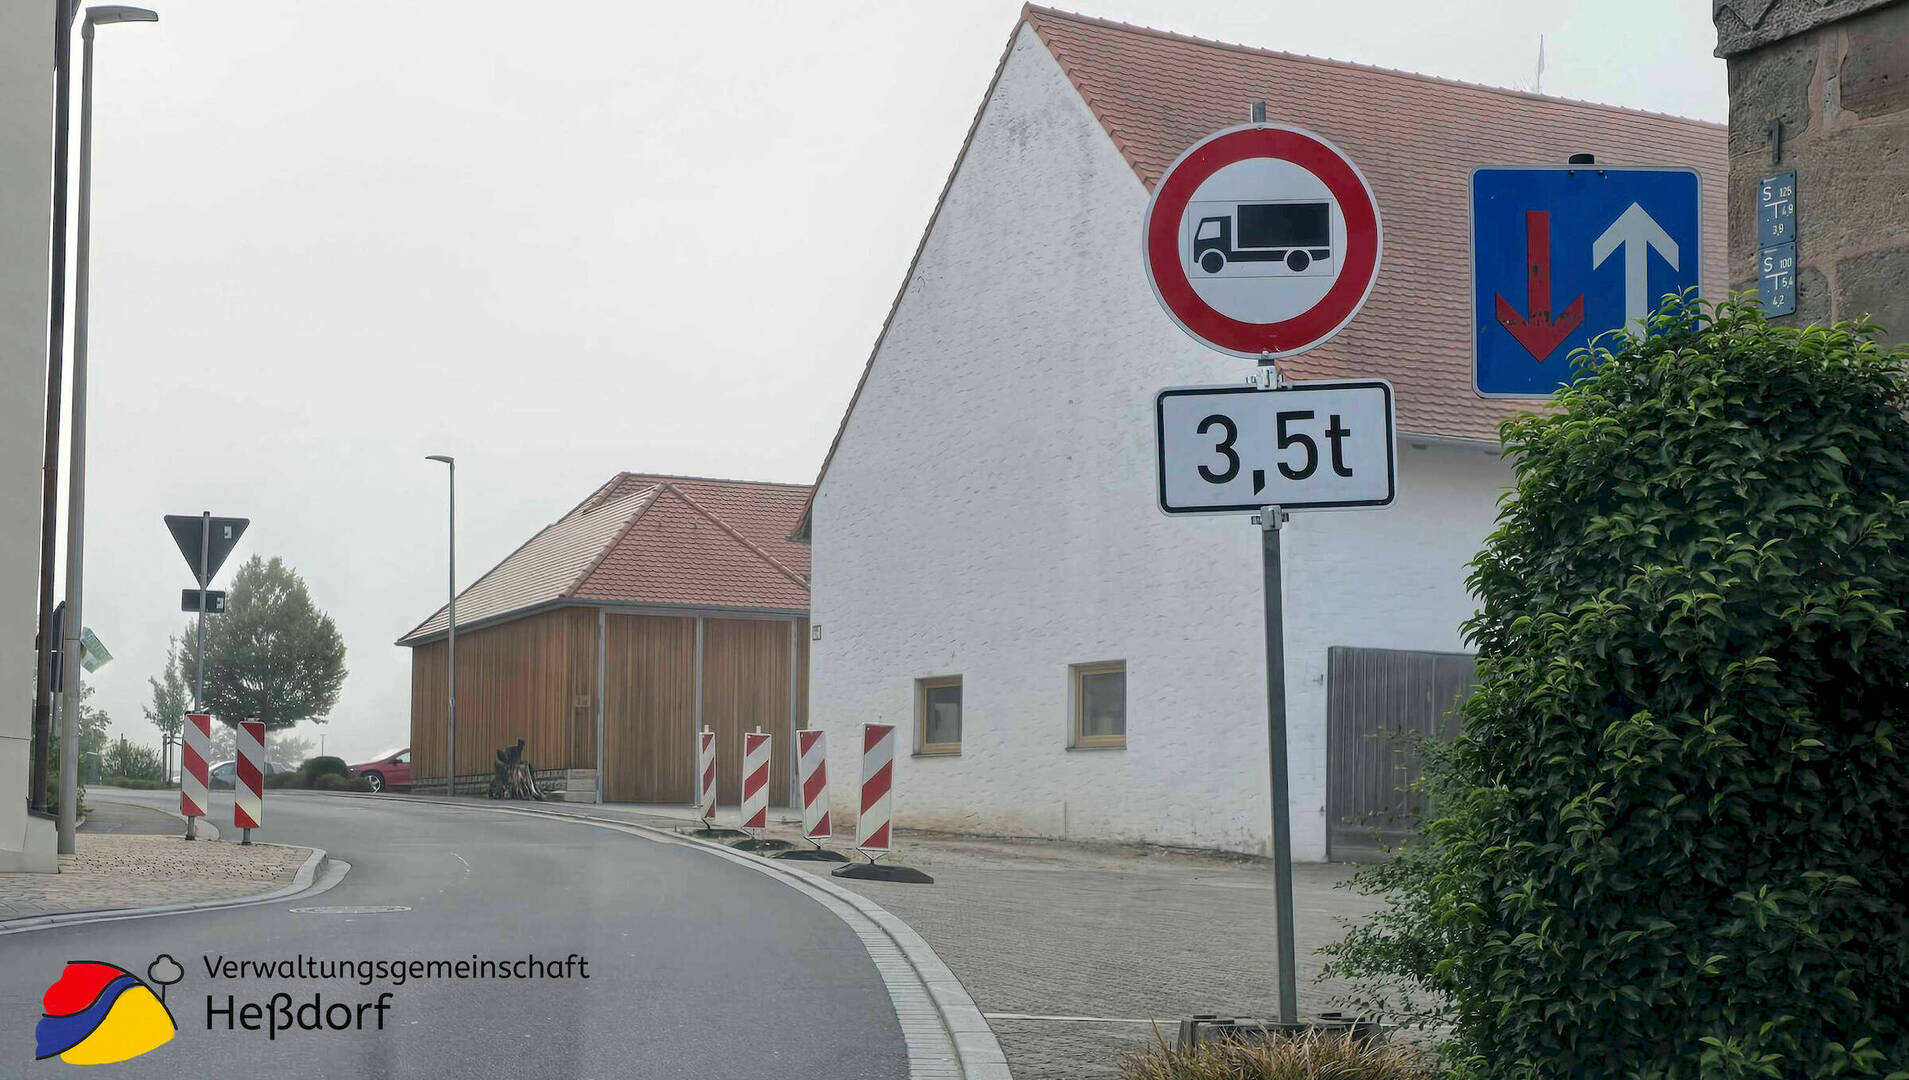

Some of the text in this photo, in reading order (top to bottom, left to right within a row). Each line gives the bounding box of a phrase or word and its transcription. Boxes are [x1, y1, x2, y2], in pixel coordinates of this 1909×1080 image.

[1763, 186, 1772, 201] S
[1764, 256, 1792, 273] S 100
[1197, 410, 1353, 496] 3,5t
